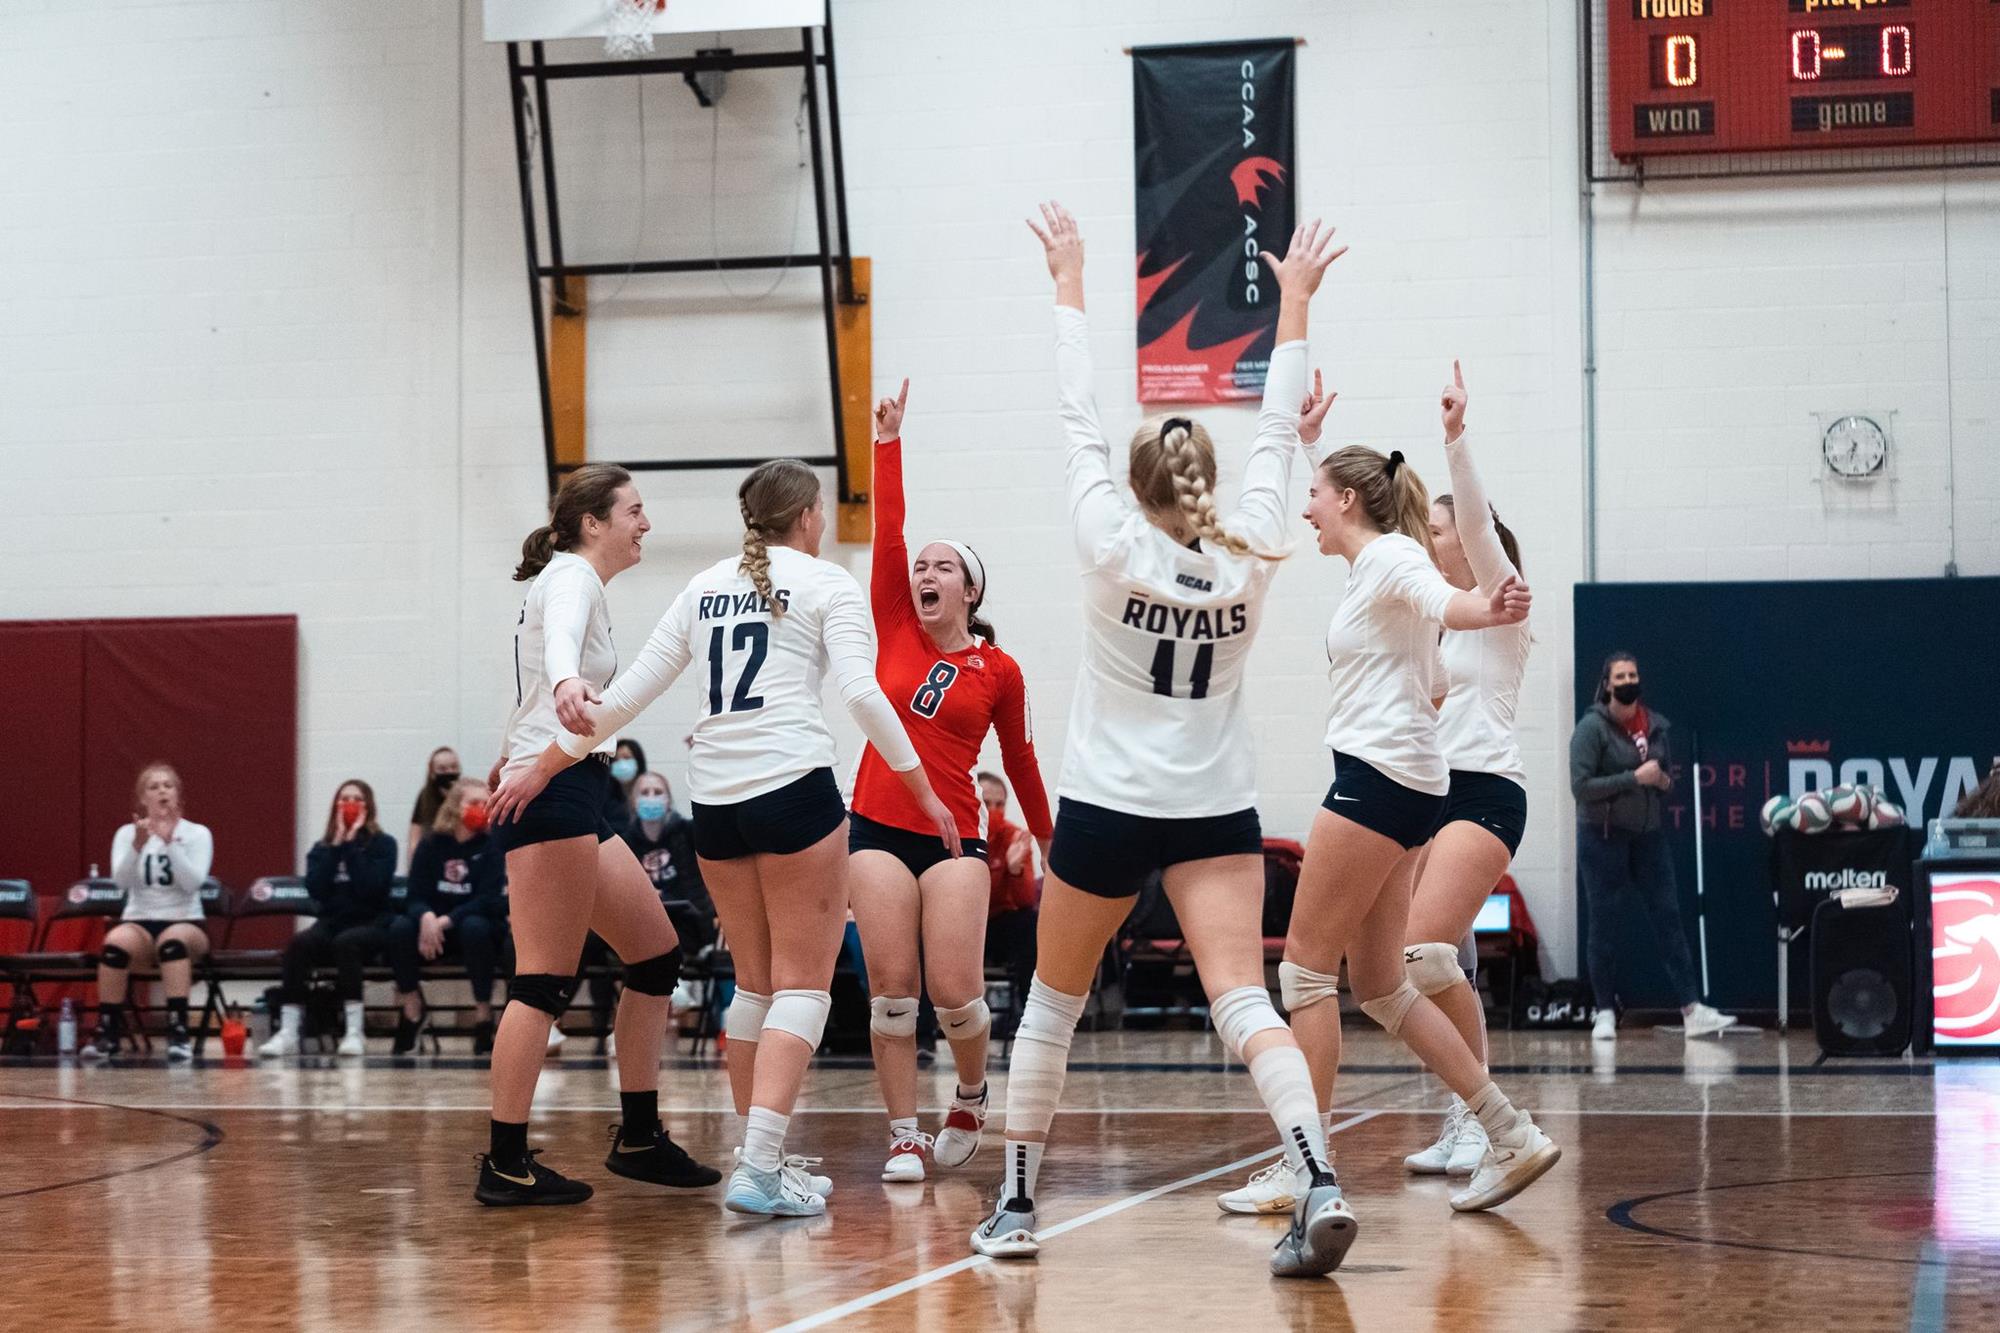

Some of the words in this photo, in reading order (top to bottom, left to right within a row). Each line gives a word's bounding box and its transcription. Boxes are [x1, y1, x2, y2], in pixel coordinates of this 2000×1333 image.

[1666, 35, 1697, 87] 0
[1241, 59, 1256, 149] CCAA
[1649, 107, 1700, 132] won
[1818, 100, 1886, 131] game
[1244, 214, 1260, 304] ACSC
[1176, 573, 1213, 592] OCAA
[699, 589, 791, 621] ROYALS
[1121, 597, 1247, 640] ROYALS
[708, 621, 769, 716] 12
[910, 660, 959, 719] 8
[1150, 639, 1214, 699] 11
[145, 854, 173, 886] 13
[1805, 868, 1887, 889] molten
